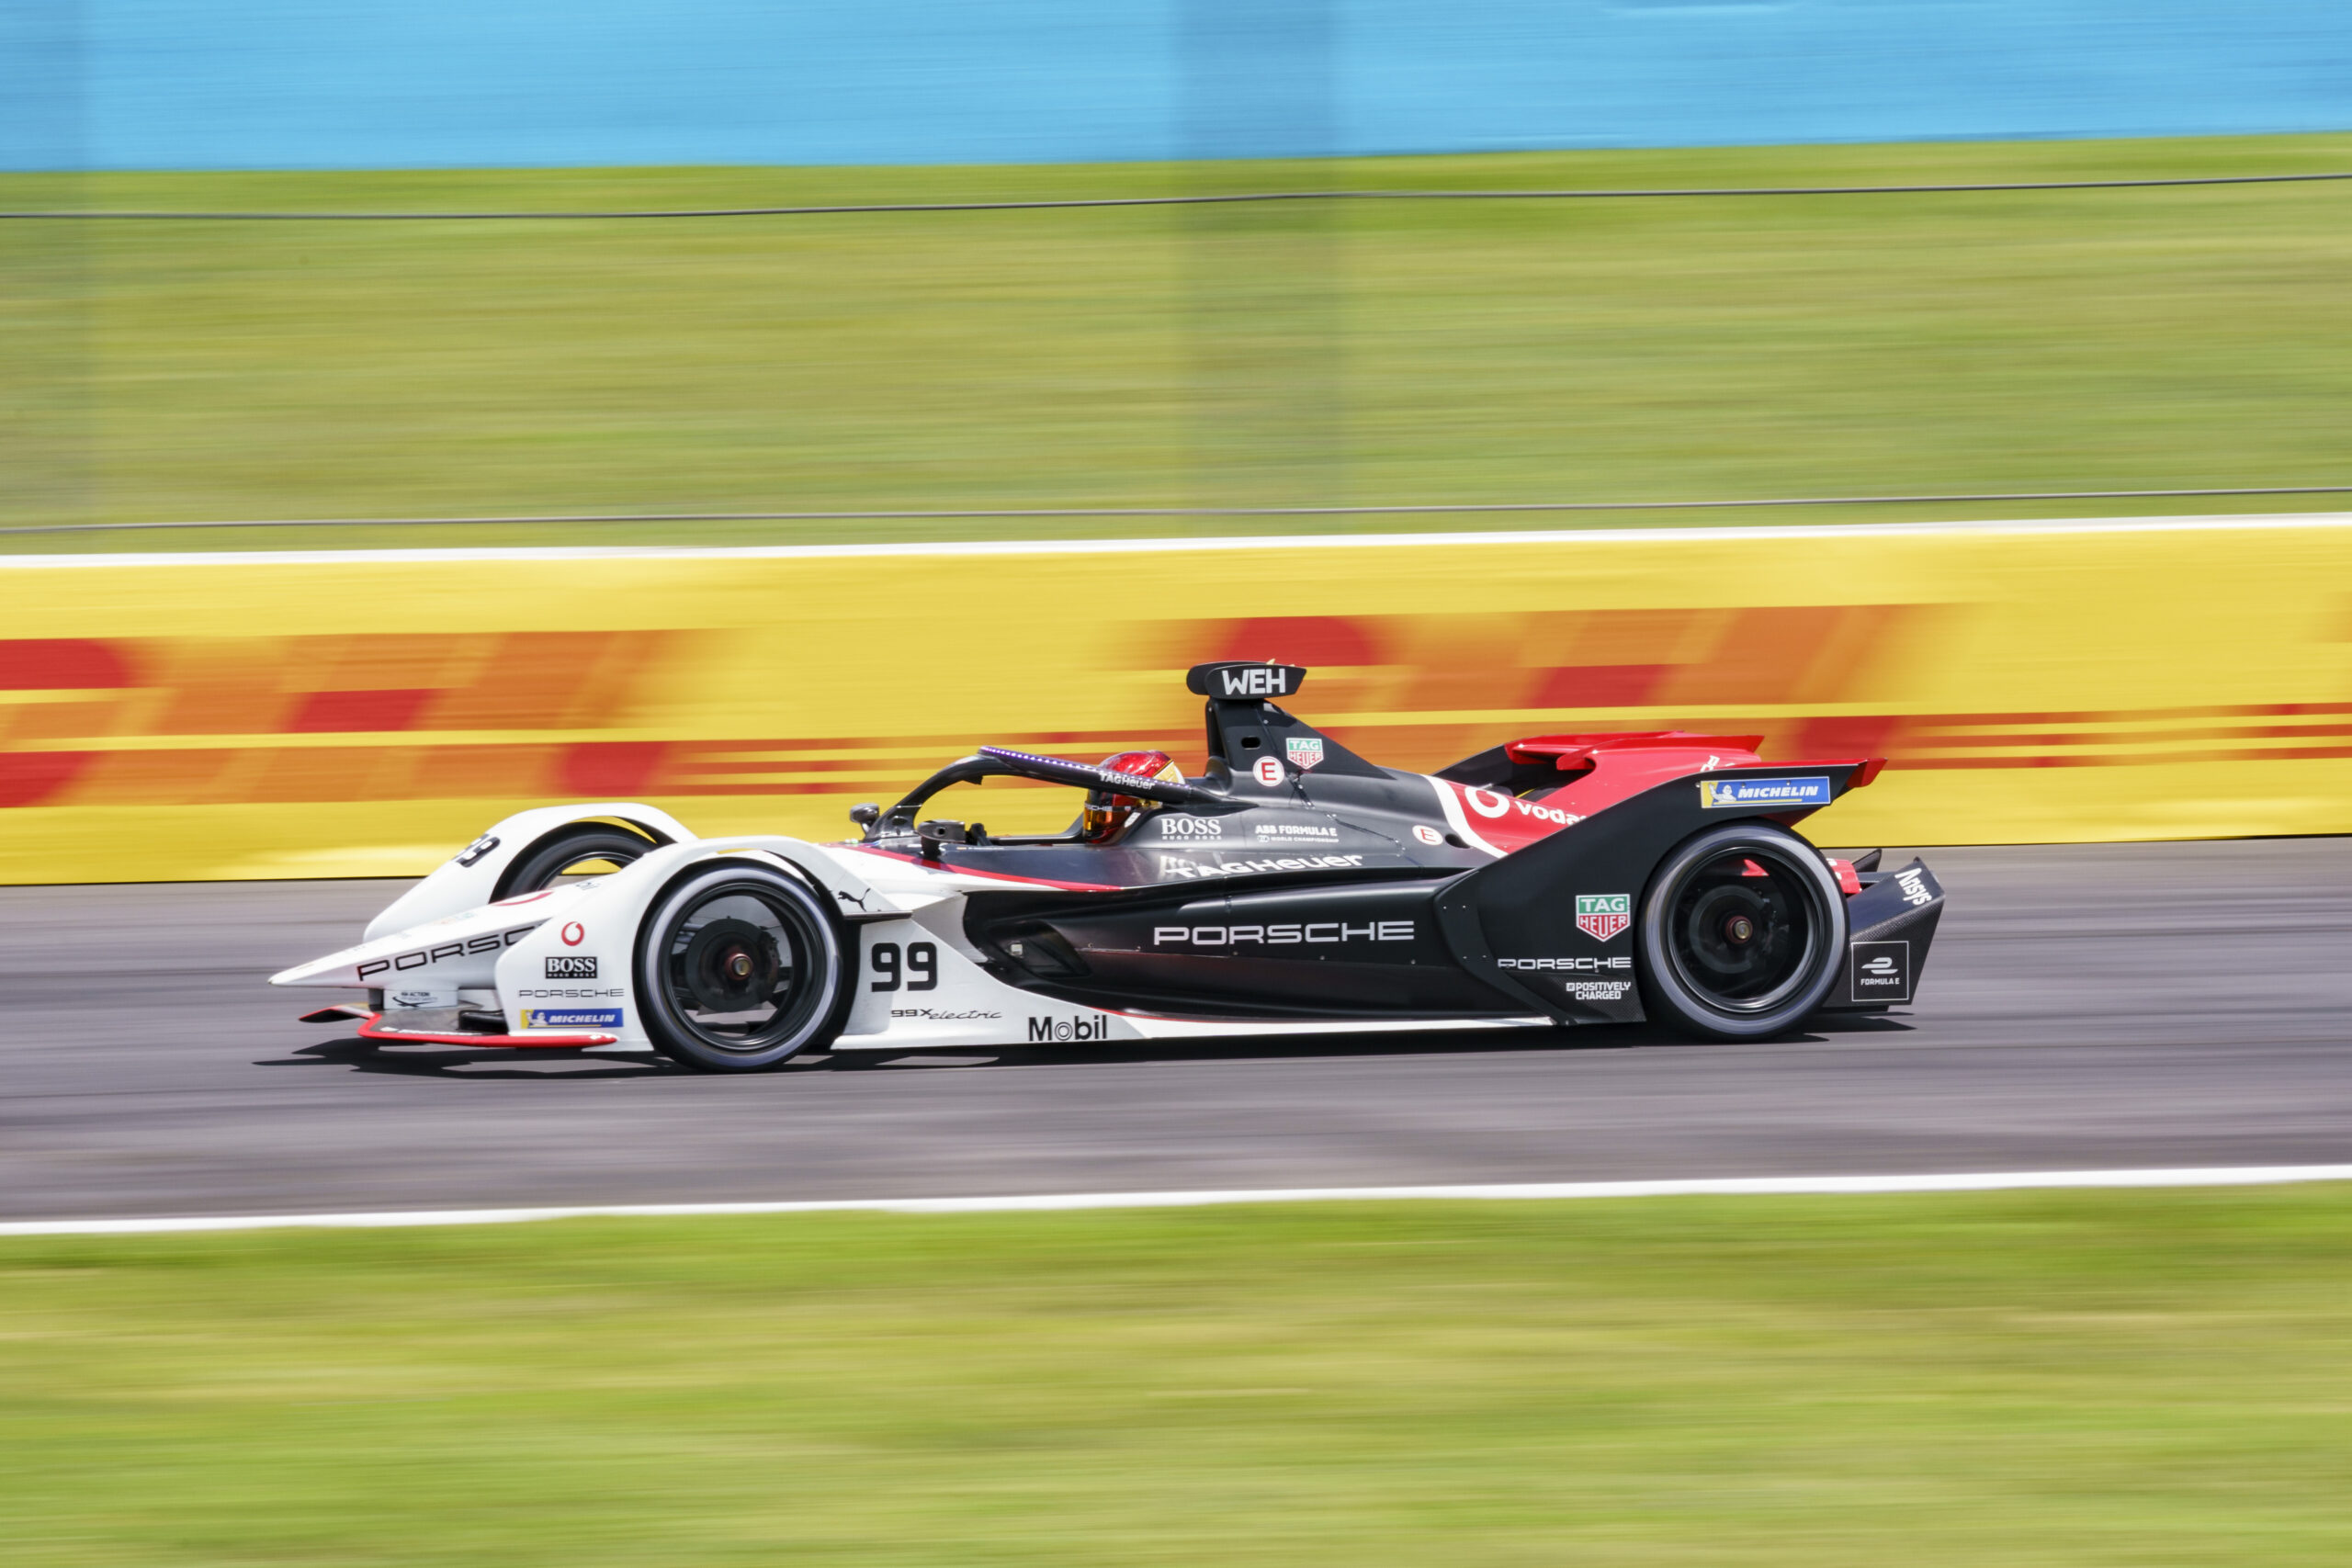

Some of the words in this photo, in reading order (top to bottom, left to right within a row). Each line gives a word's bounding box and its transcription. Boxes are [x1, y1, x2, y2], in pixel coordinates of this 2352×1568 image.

[1222, 668, 1285, 695] WEH
[1289, 740, 1320, 750] TAG
[1288, 750, 1322, 767] HEUER
[1261, 761, 1277, 781] E
[1737, 785, 1819, 798] MICHELIN
[1514, 800, 1587, 826] voda
[1160, 818, 1222, 835] BOSS
[1255, 825, 1278, 834] ABB
[1278, 825, 1329, 836] FORMULA
[1894, 867, 1932, 906] Ansys
[1580, 897, 1625, 912] TAG
[1154, 920, 1415, 946] PORSCHE
[1580, 915, 1627, 938] HEUER
[356, 924, 543, 981] PORSC
[547, 957, 596, 973] BOSS
[871, 942, 937, 992] 99
[1498, 956, 1632, 970] PORSCHE
[1576, 981, 1631, 991] POSITIVELY
[1860, 977, 1894, 986] FORMULA
[518, 988, 625, 998] PORSCHE
[1576, 991, 1622, 1000] CHARGED
[548, 1014, 616, 1023] MICHELIN
[1028, 1014, 1108, 1042] Mobil
